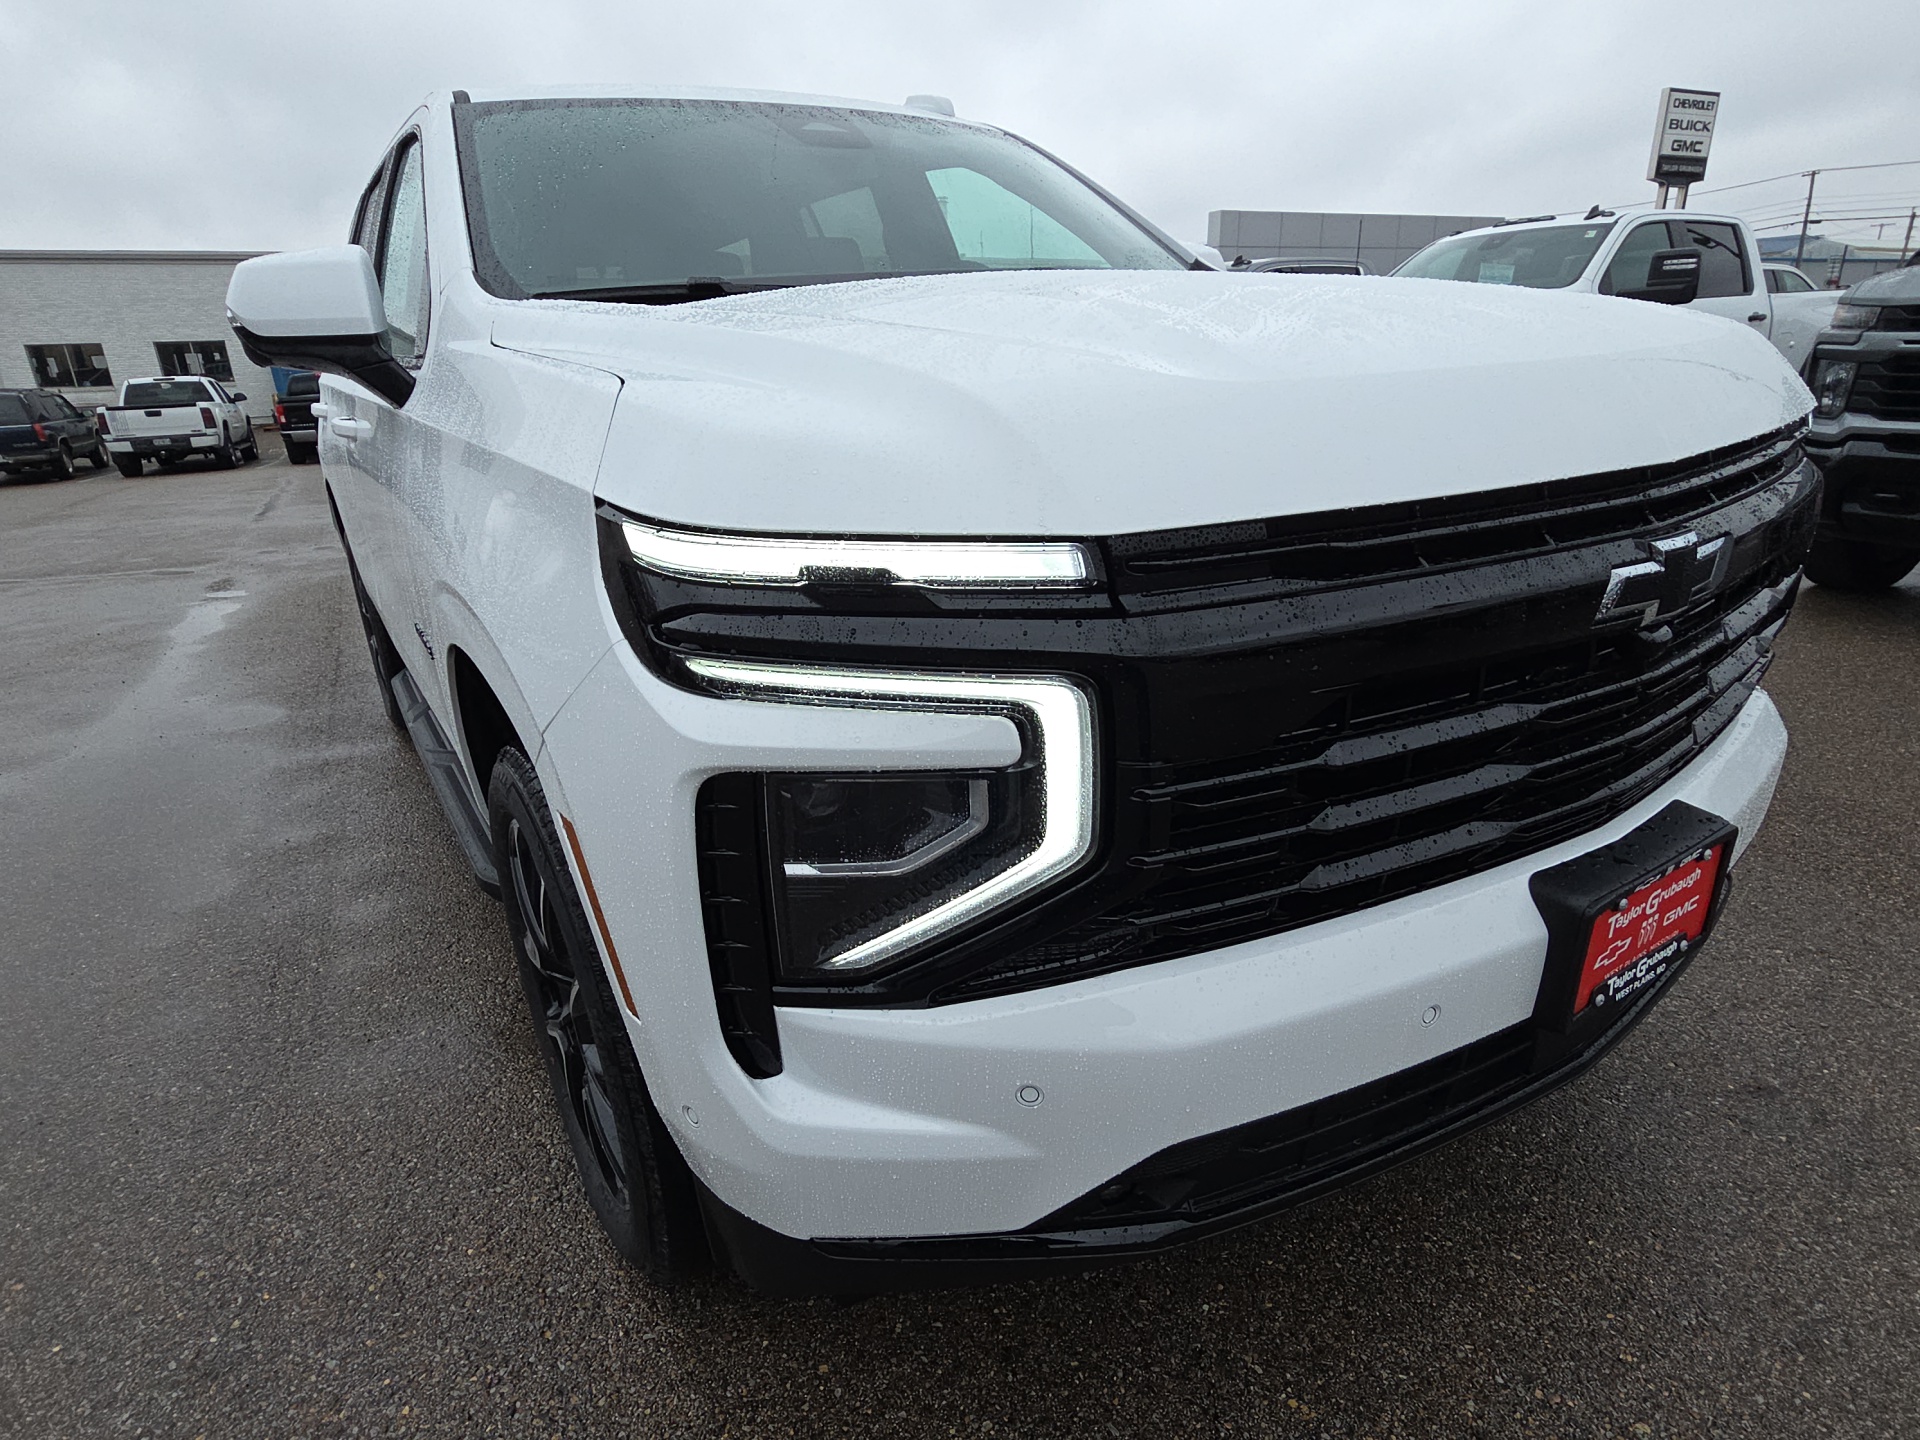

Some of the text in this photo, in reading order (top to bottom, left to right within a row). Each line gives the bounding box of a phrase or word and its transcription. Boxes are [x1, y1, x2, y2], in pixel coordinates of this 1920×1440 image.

[1673, 98, 1716, 111] CHEVROLET
[1668, 118, 1712, 132] BUICK
[1671, 139, 1703, 153] GMC
[1608, 868, 1701, 938] Taylor Grubaugh
[1663, 895, 1699, 926] GMC
[1607, 940, 1678, 996] Taylor Grubaugh
[1616, 984, 1633, 1001] WEST
